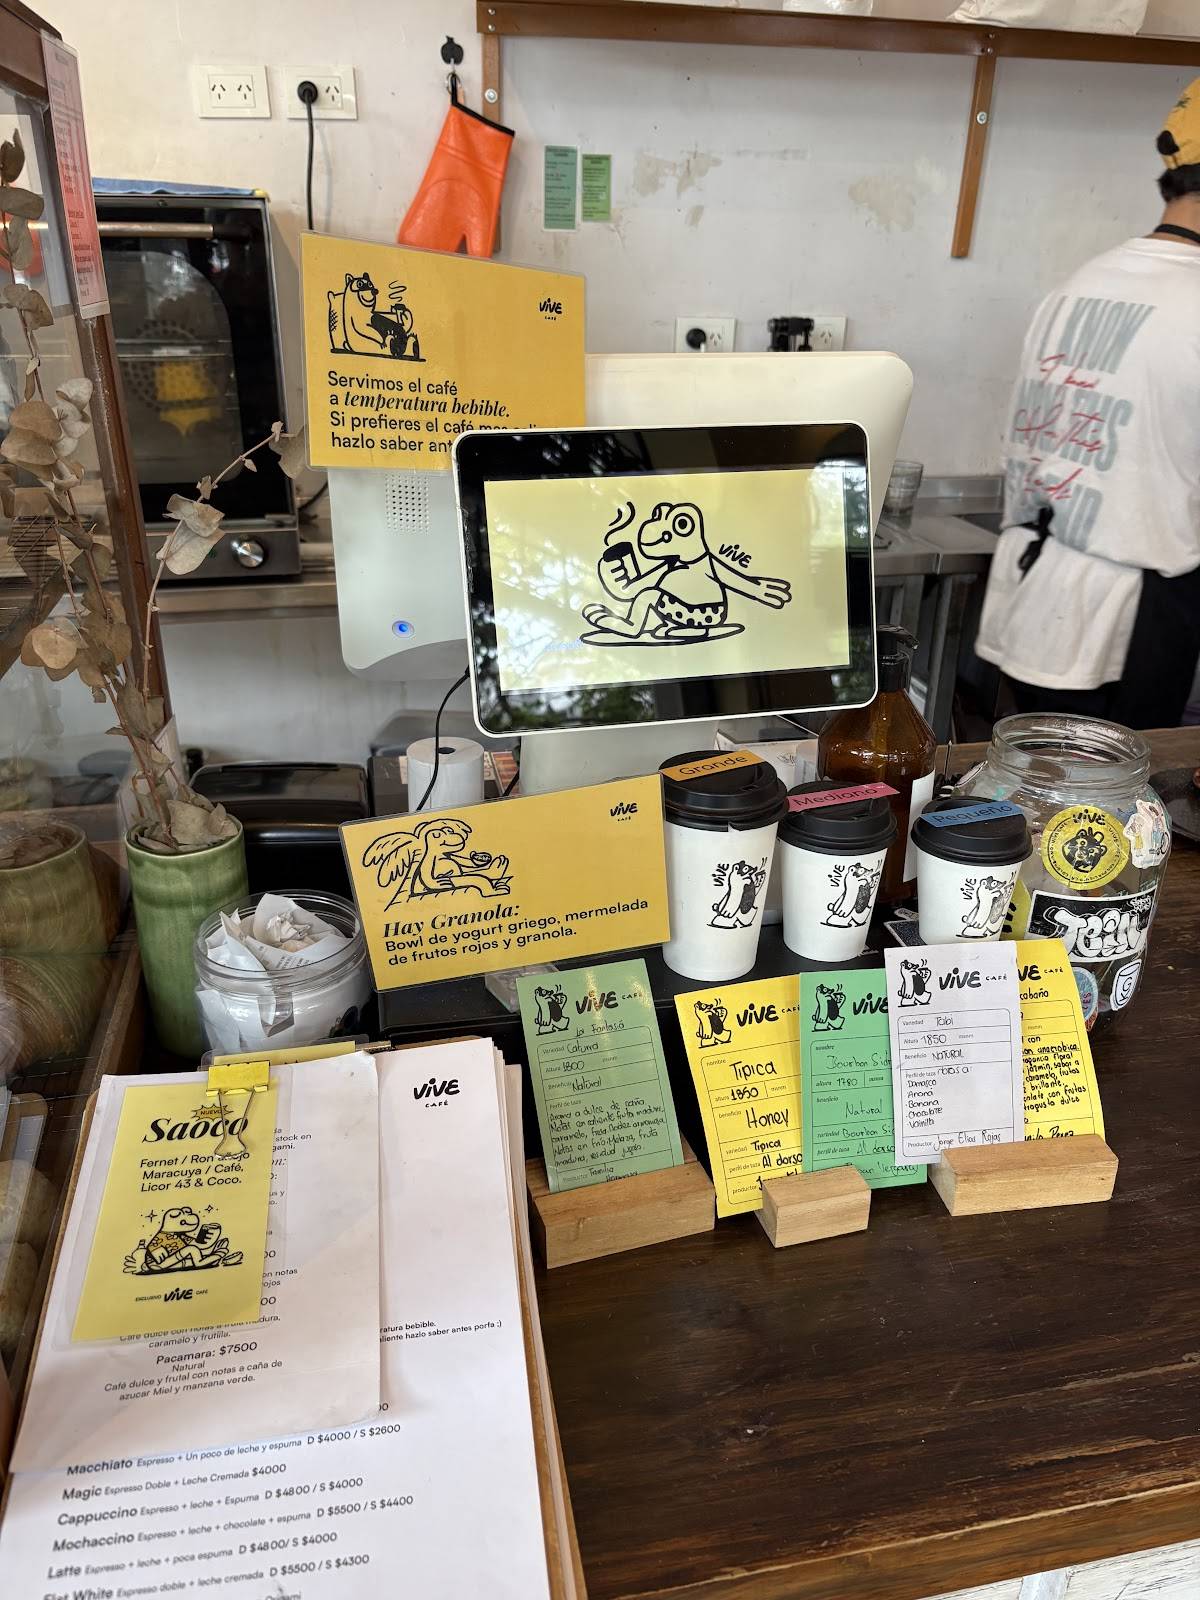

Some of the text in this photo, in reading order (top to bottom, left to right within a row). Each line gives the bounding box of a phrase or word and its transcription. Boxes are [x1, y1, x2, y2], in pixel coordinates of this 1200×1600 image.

[327, 371, 458, 396] Servimos el café
[330, 391, 510, 418] a temperatura bebible.
[330, 411, 473, 434] Si prefieres el café
[331, 432, 425, 452] hazlo saber
[679, 754, 748, 776] Grande
[794, 787, 878, 807] Mediano
[383, 904, 520, 938] Hay Granola:
[385, 899, 648, 952] Bowl de yogurt griego, mermelada
[388, 926, 577, 966] de frutos rojos y granola.
[985, 973, 1008, 981] CAFÉ
[1044, 966, 1064, 975] CAFÉ
[921, 1034, 947, 1045] 1850
[1027, 1036, 1041, 1044] con
[425, 1099, 449, 1108] CAFÉ
[845, 1099, 883, 1118] Natural
[745, 1107, 789, 1128] Honey
[142, 1117, 248, 1143] Saoco
[275, 1134, 298, 1142] stock
[842, 1127, 878, 1137] Bourbon
[140, 1154, 214, 1168] Fernet Ron
[762, 1153, 803, 1168] Al dorso
[141, 1176, 242, 1192] Licor 43 & Coco.
[142, 1168, 202, 1180] Maracuya
[275, 1268, 298, 1277] notas
[405, 1320, 436, 1330] bebible.
[405, 1320, 495, 1340] hazlo saber antes porfa
[149, 1336, 198, 1349] caramelo y
[156, 1341, 258, 1364] Pacamara: $7500
[104, 1382, 127, 1392] Café
[129, 1378, 155, 1389] dulce
[157, 1377, 163, 1386] y
[165, 1373, 190, 1385] frutal
[192, 1371, 209, 1380] con
[211, 1367, 237, 1376] notas
[247, 1361, 269, 1371] caña
[271, 1359, 283, 1368] de
[172, 1361, 206, 1372] Natural
[119, 1374, 256, 1401] azucar Miel y manzana verde.
[66, 1424, 401, 1476] Macchiato Espresso Un poco de leche y espuma $4000 $2600
[62, 1463, 287, 1501] Magic Espresso Doble Leche Cremada $4000
[57, 1477, 364, 1526] Cappuccino Espresso leche Espuma $4800 $4000
[52, 1495, 414, 1552] Mochaccino Espresso leche chocolate espuma $5500 $4400
[47, 1564, 82, 1580] Latte
[84, 1562, 126, 1576] Espresso
[136, 1557, 161, 1569] leche
[172, 1554, 195, 1565] poca
[197, 1548, 233, 1561] espuma
[301, 1531, 338, 1546] $4000
[73, 1587, 114, 1600] White
[159, 1579, 187, 1591] doble
[197, 1575, 223, 1586] leche
[224, 1570, 264, 1583] cremada
[280, 1561, 316, 1576] $5500
[335, 1554, 370, 1568] $4300
